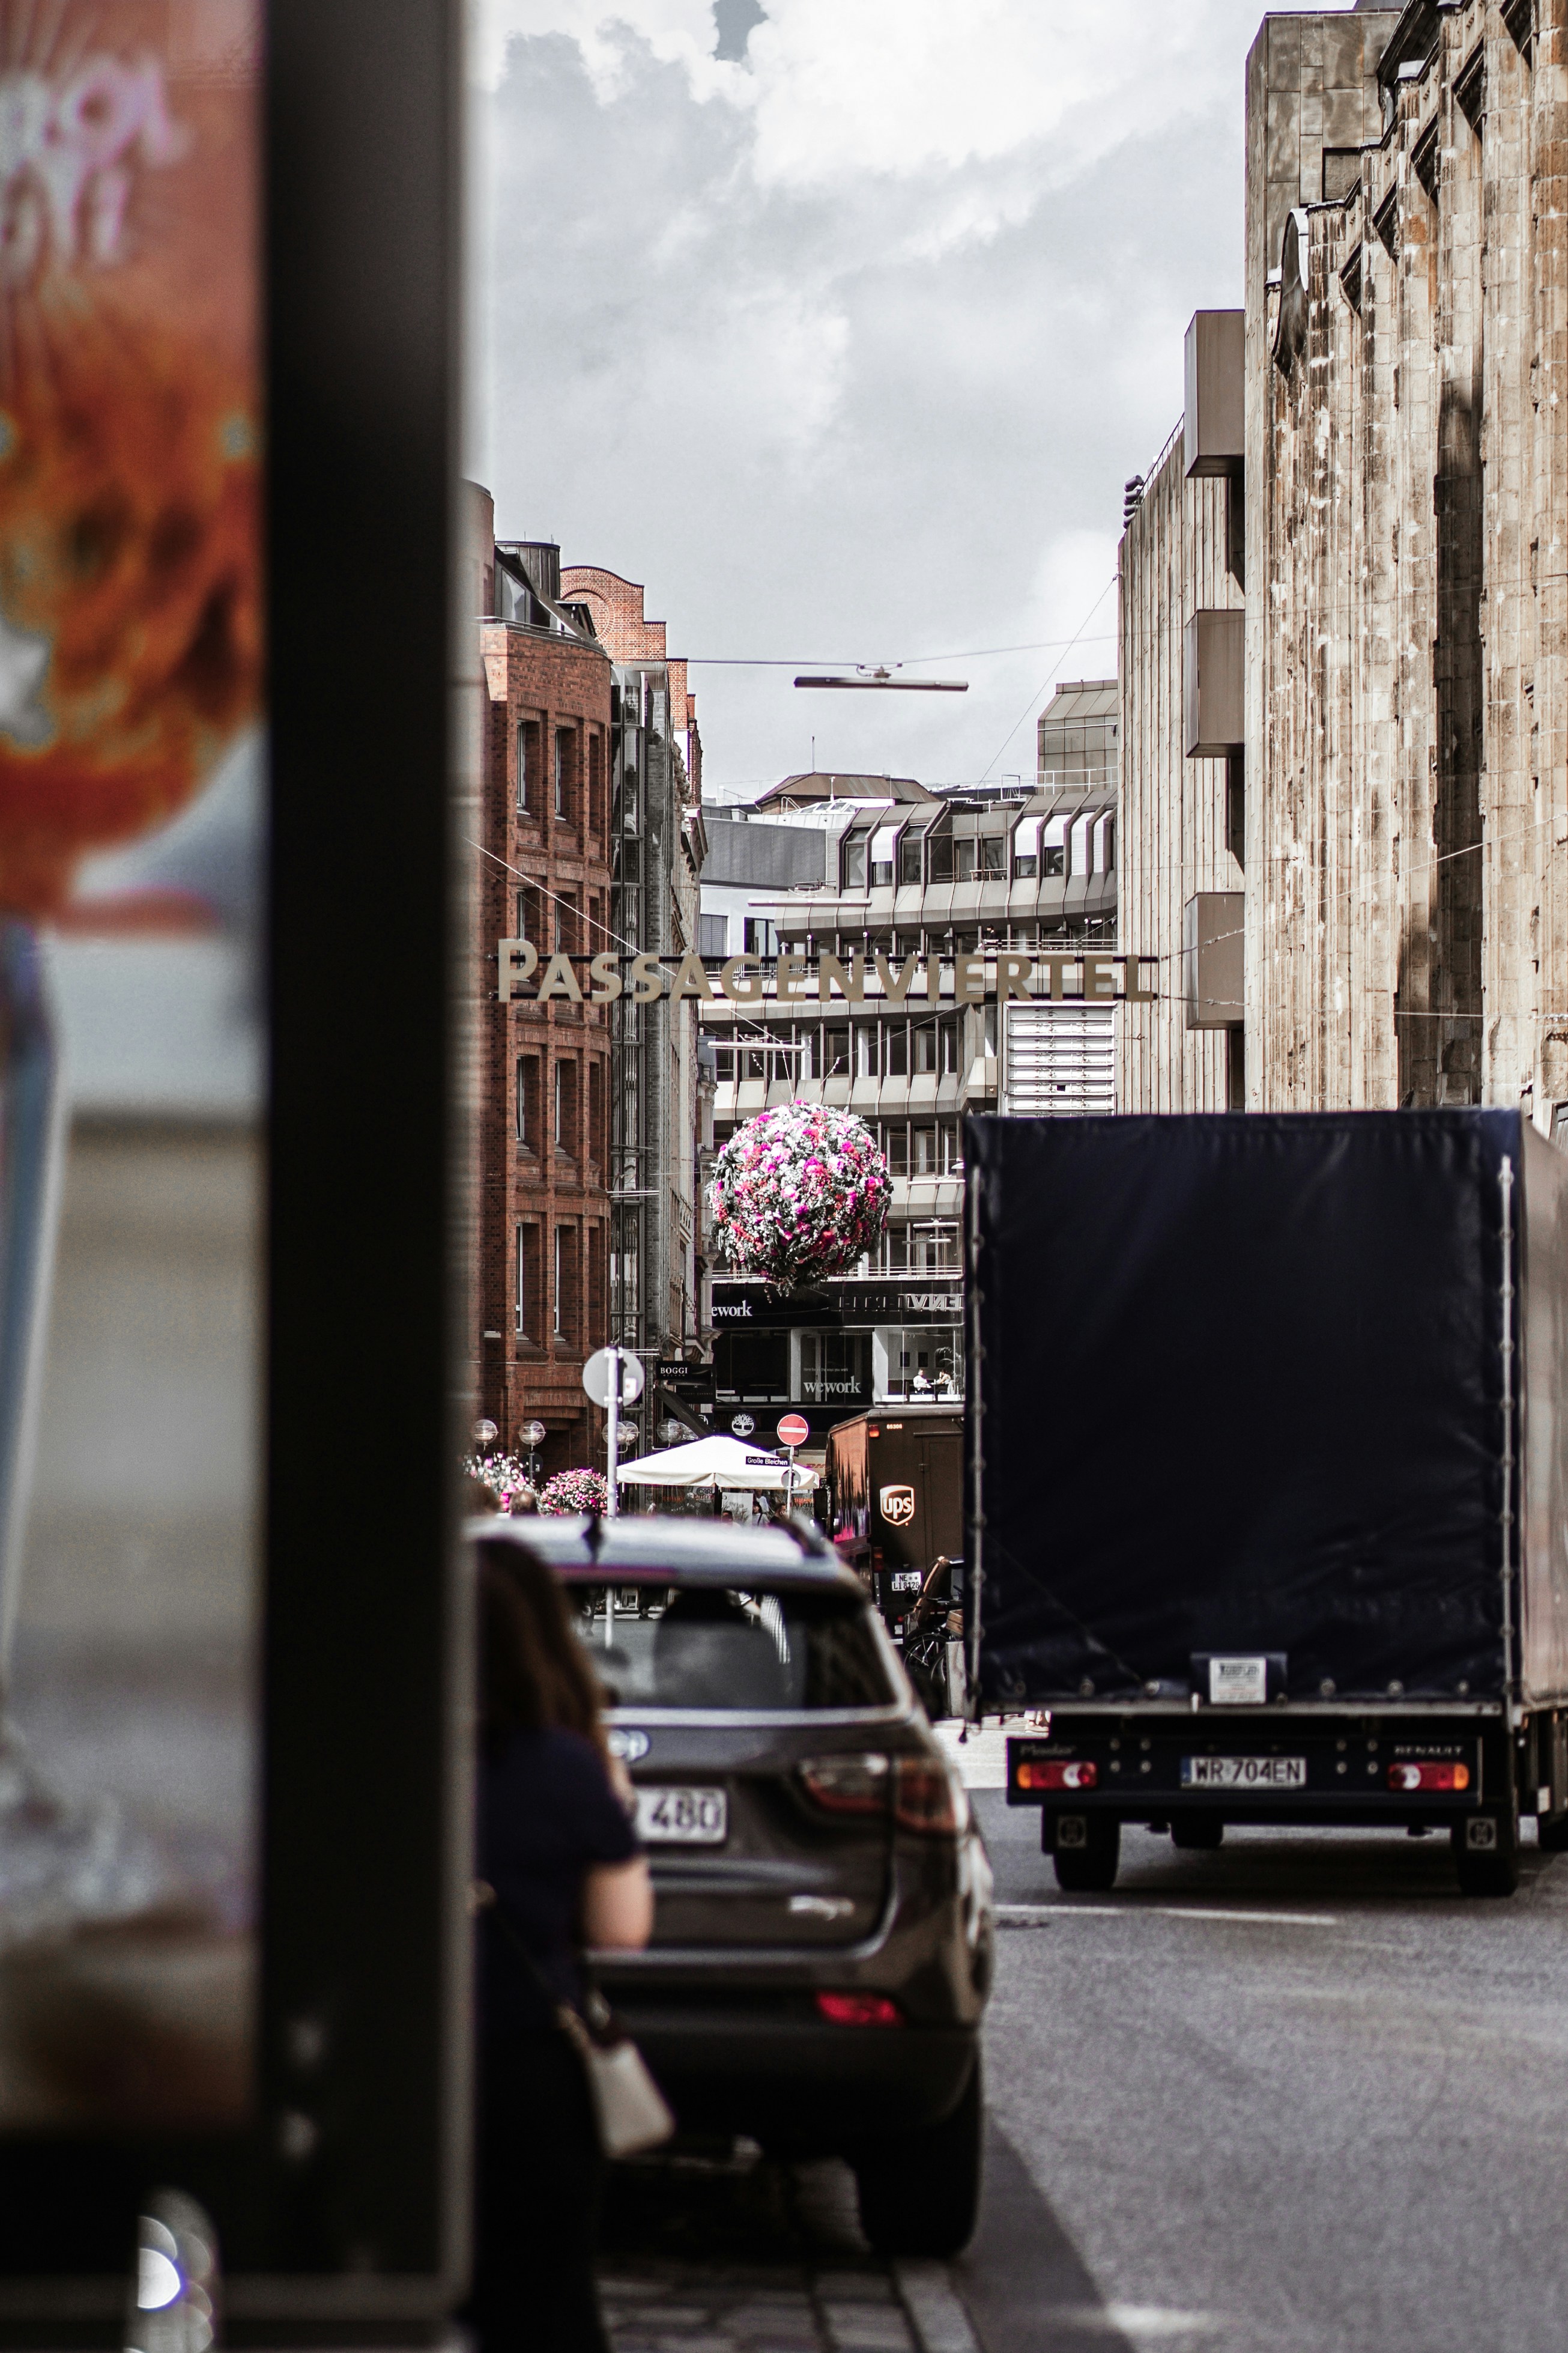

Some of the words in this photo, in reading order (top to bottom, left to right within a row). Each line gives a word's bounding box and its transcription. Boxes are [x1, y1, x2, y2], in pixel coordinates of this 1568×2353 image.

[498, 938, 1154, 1003] PASSAGENVIERTEL
[803, 1375, 861, 1393] wework
[883, 1497, 912, 1519] ups
[1196, 1759, 1224, 1781] WR
[1232, 1759, 1300, 1782] 704EN
